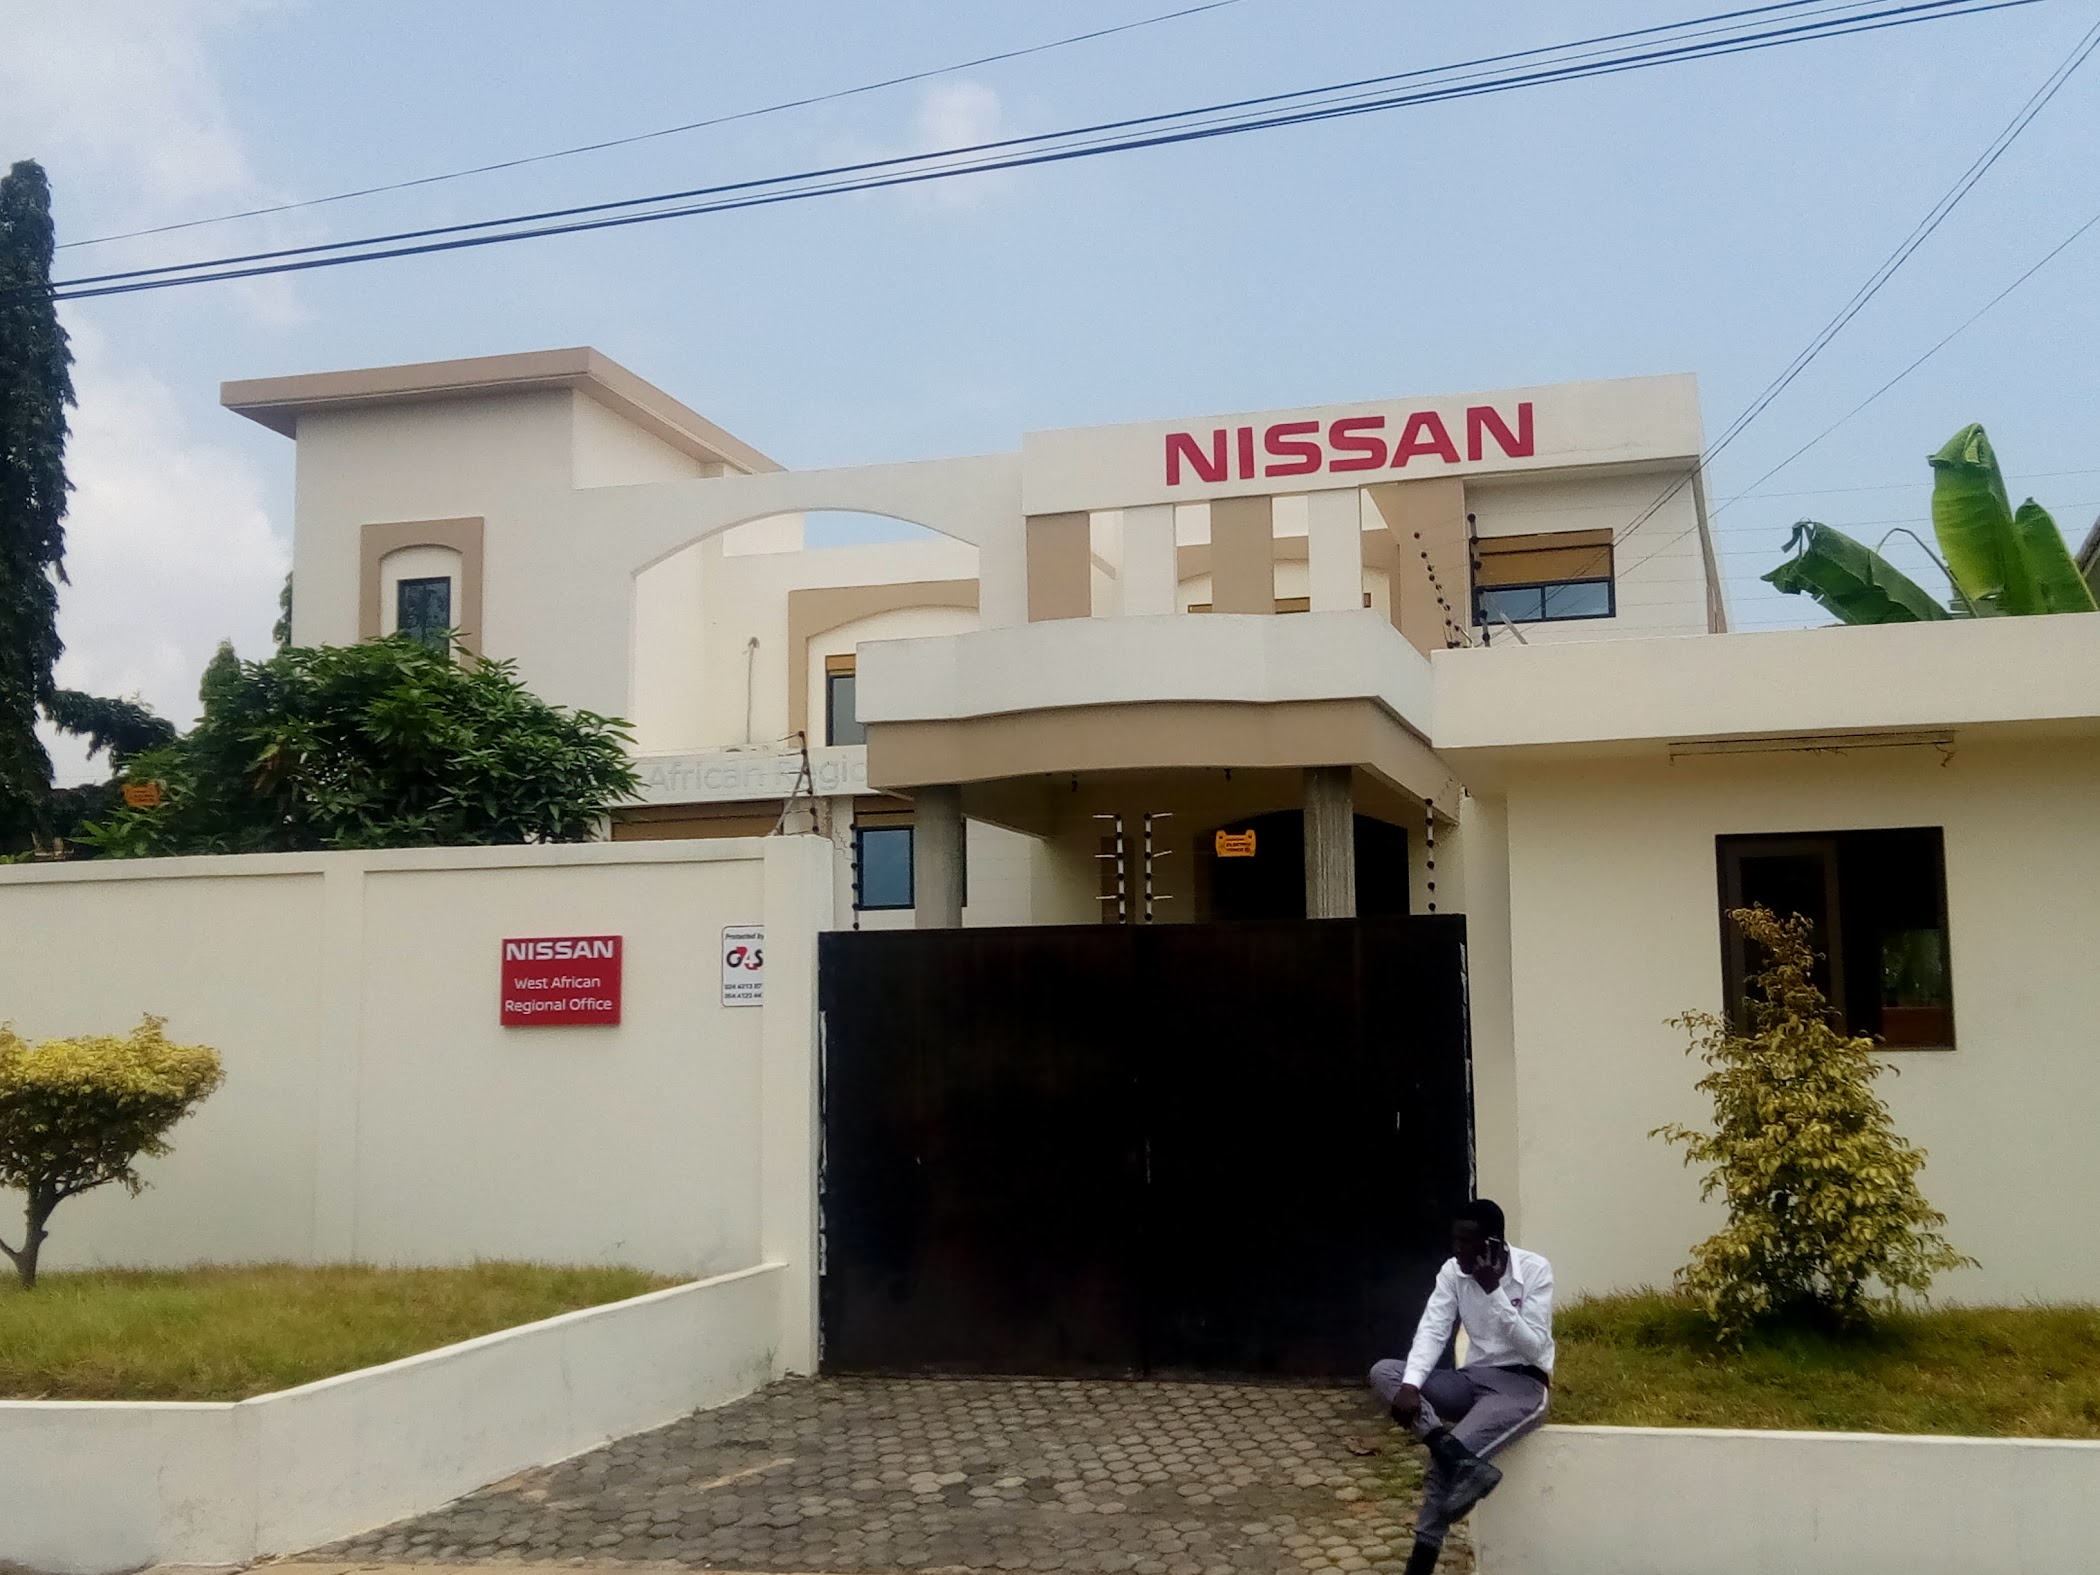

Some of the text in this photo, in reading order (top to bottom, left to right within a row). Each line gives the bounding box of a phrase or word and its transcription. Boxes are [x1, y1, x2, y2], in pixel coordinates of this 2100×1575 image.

[1165, 402, 1534, 486] NISSAN
[650, 759, 765, 791] African
[506, 940, 614, 961] NISSAN
[514, 975, 601, 990] West African
[504, 997, 613, 1015] Regional Office
